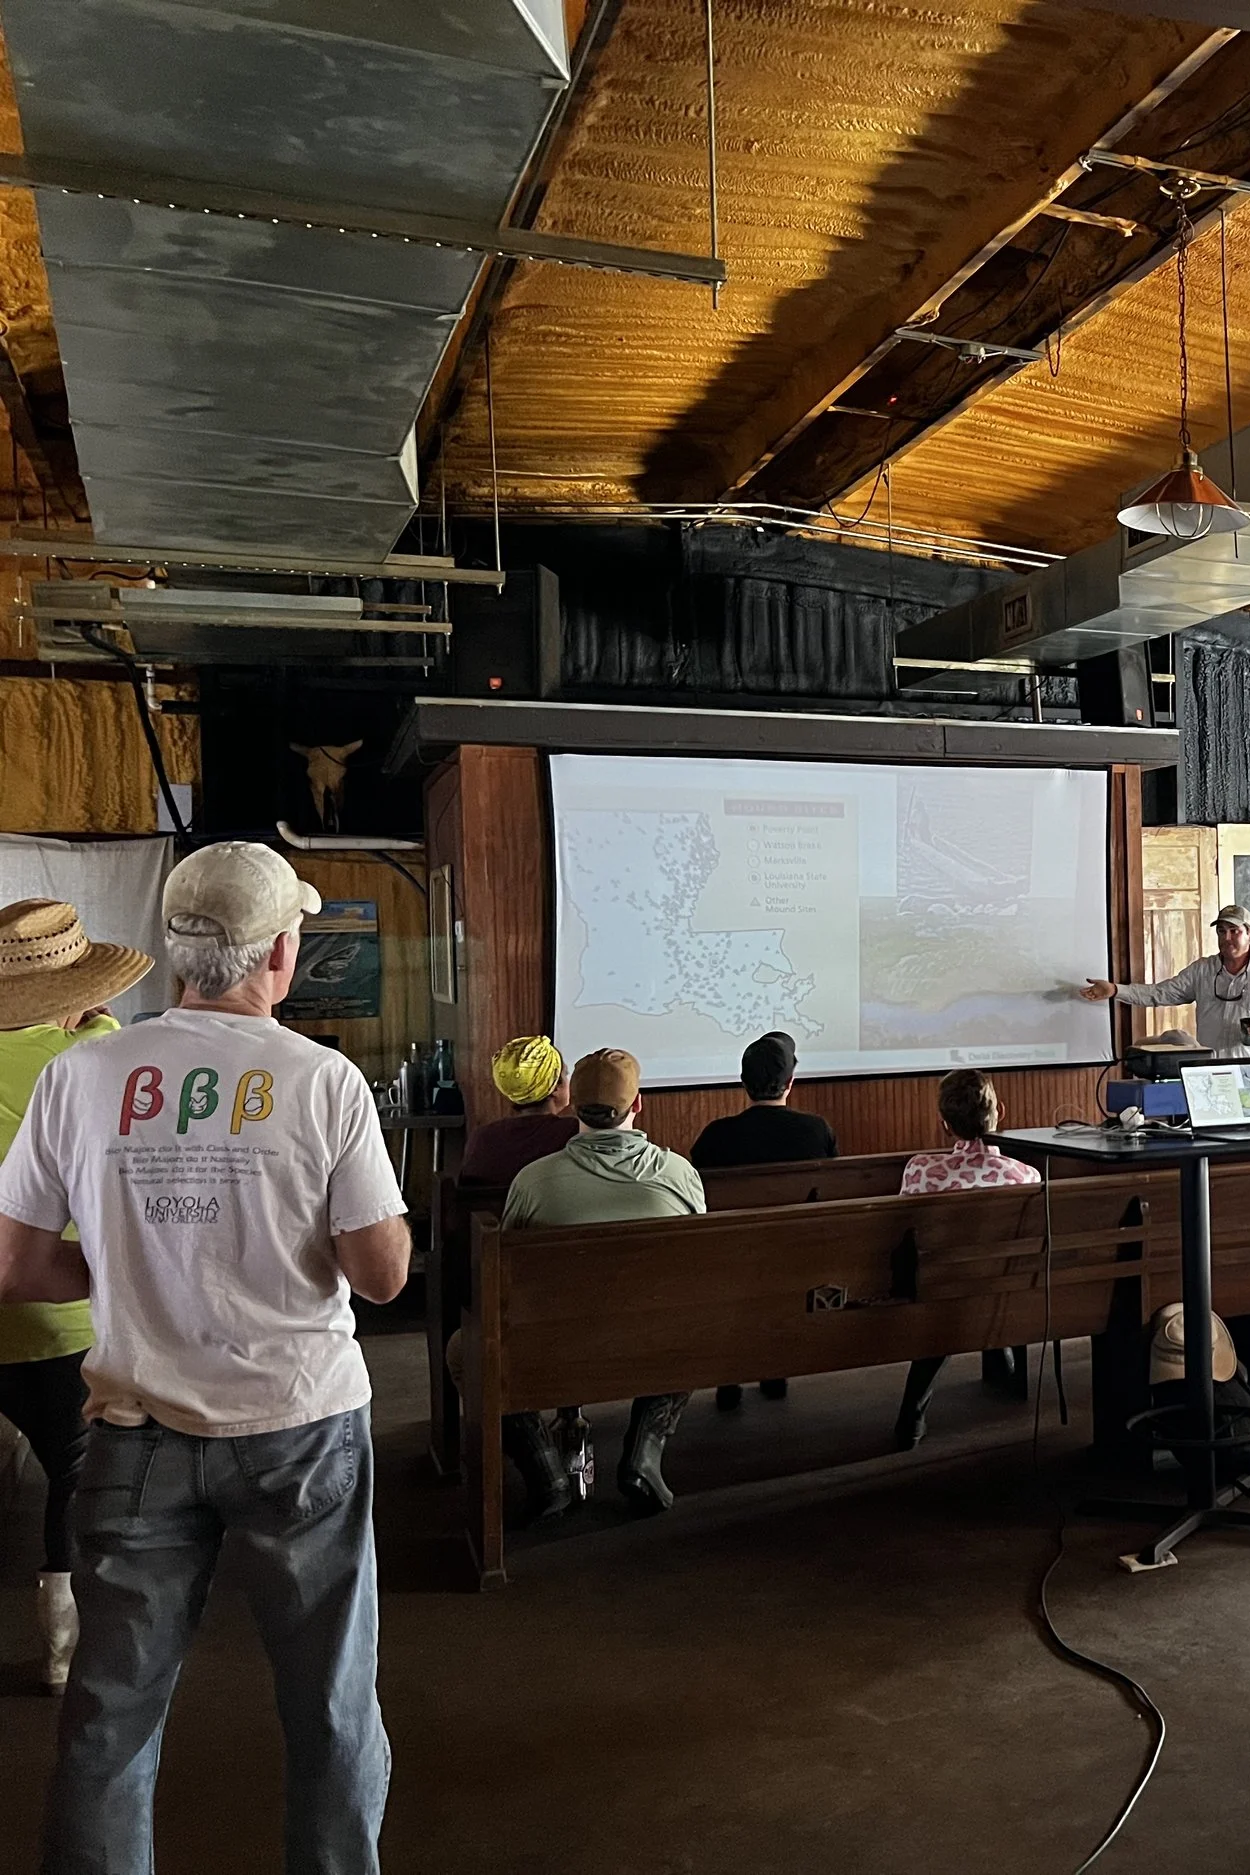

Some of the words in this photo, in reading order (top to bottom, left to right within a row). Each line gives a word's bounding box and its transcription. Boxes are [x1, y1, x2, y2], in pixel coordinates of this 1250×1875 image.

[764, 871, 804, 881] Louisiana
[806, 872, 828, 881] State
[764, 880, 806, 890] University
[765, 896, 789, 905] Other
[765, 904, 796, 913] Mound
[797, 904, 817, 913] Sites
[232, 1145, 249, 1154] and
[252, 1146, 280, 1157] Order
[228, 1166, 262, 1177] Species
[146, 1196, 220, 1209] LOYOLA
[145, 1206, 220, 1219] UNIVERSITY
